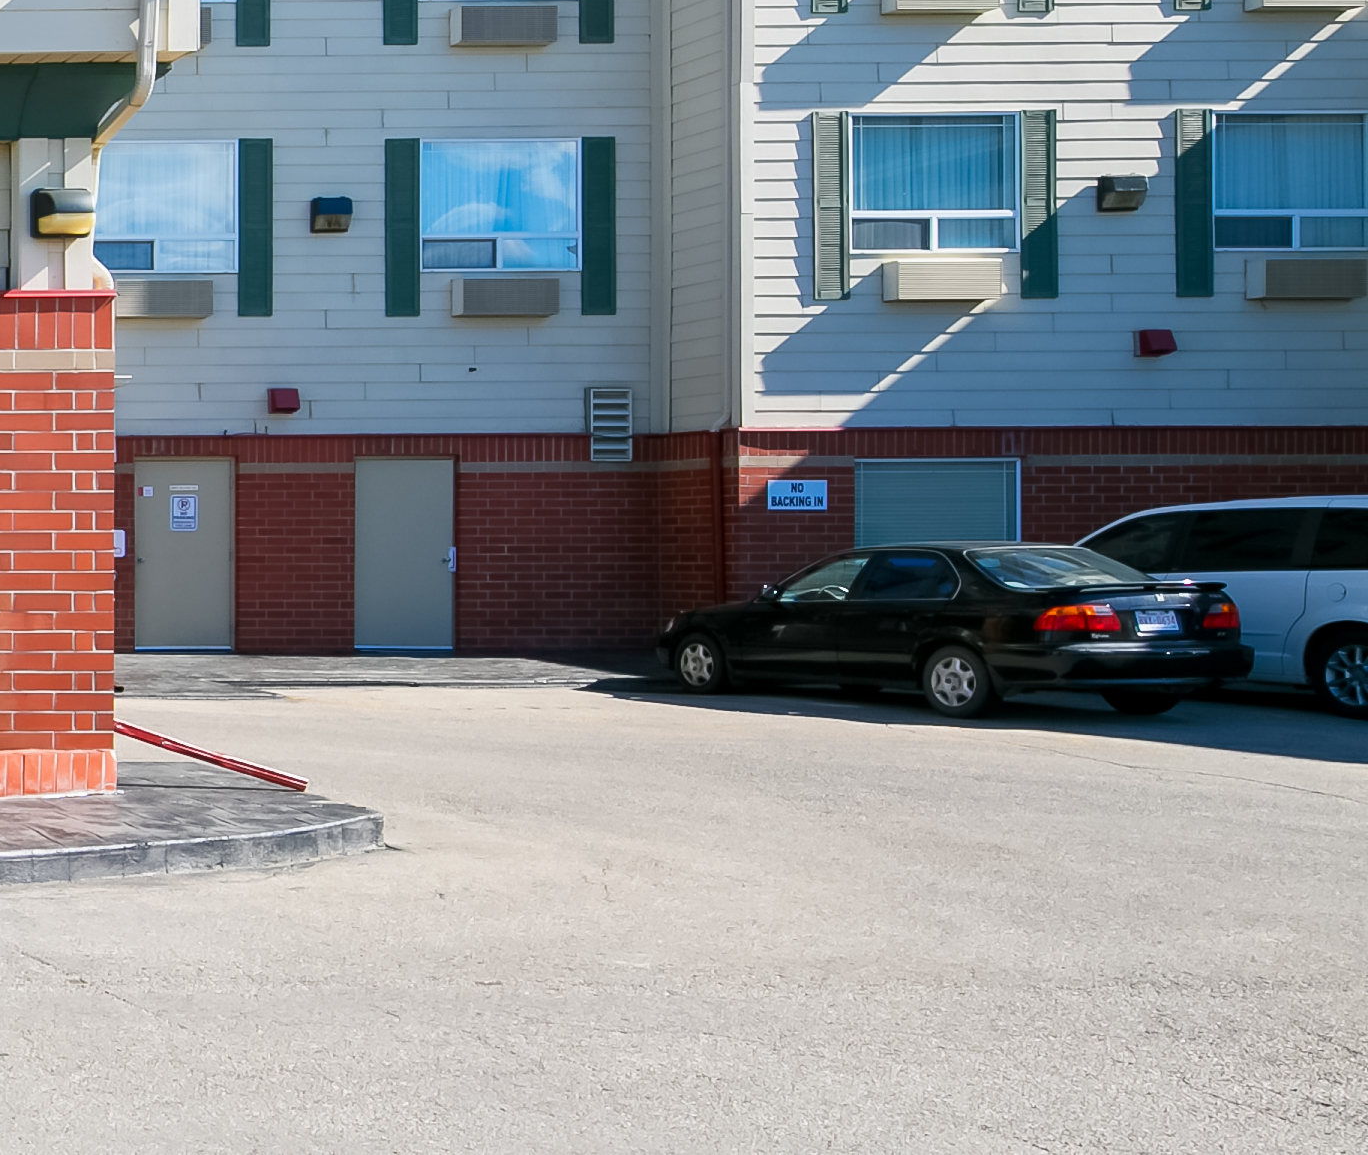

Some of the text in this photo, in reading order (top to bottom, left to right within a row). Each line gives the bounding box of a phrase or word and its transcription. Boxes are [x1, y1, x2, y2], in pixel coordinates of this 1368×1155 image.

[791, 483, 804, 493] NO
[771, 496, 824, 507] BACKING IN
